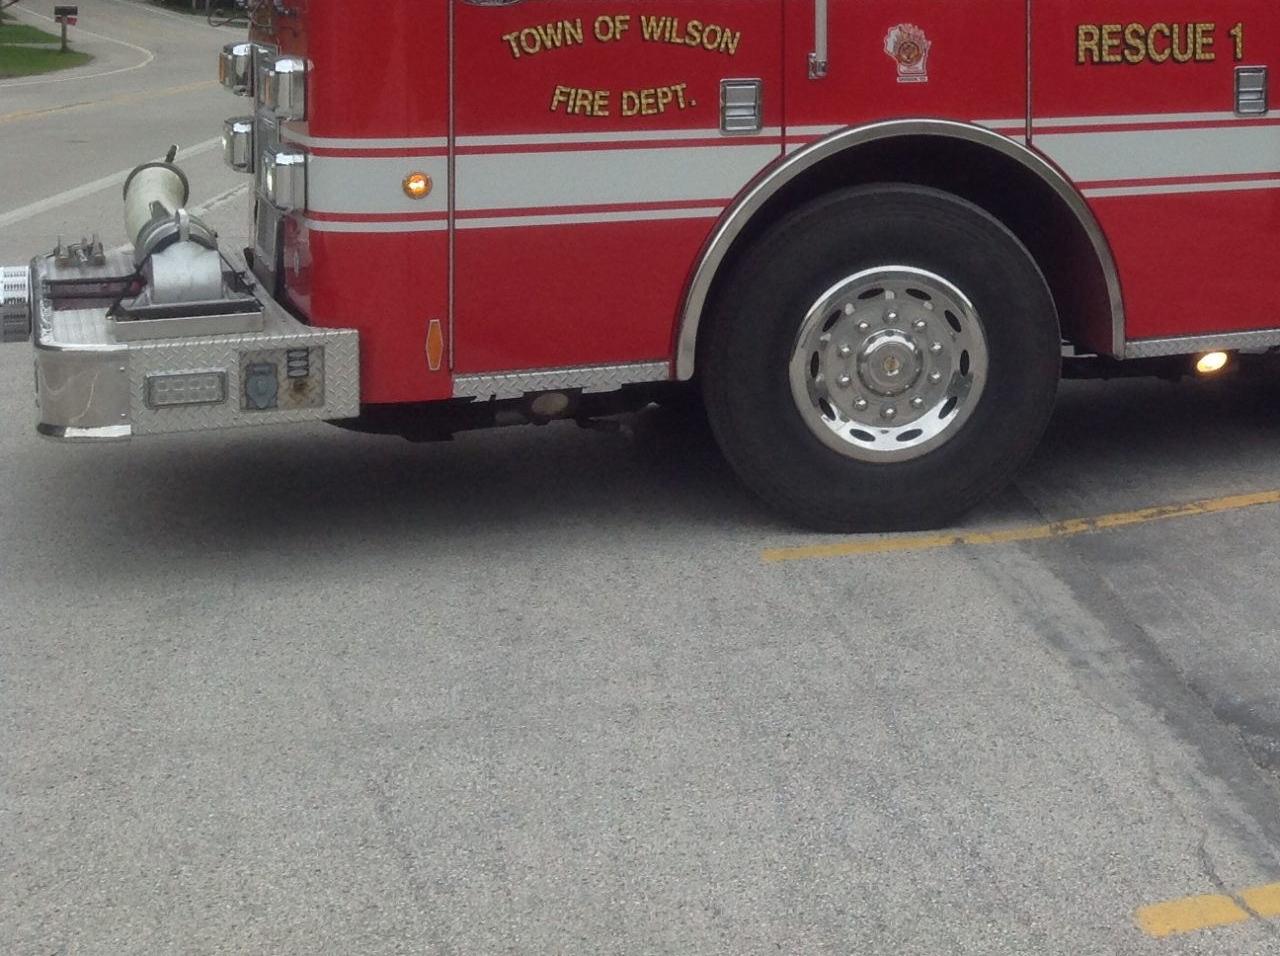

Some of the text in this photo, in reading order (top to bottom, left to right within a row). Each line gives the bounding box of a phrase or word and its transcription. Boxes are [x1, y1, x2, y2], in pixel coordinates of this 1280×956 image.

[502, 14, 741, 58] TOWN OF WILSON
[1077, 22, 1243, 63] RESCUE 1
[550, 83, 697, 117] FIRE DEPT.
